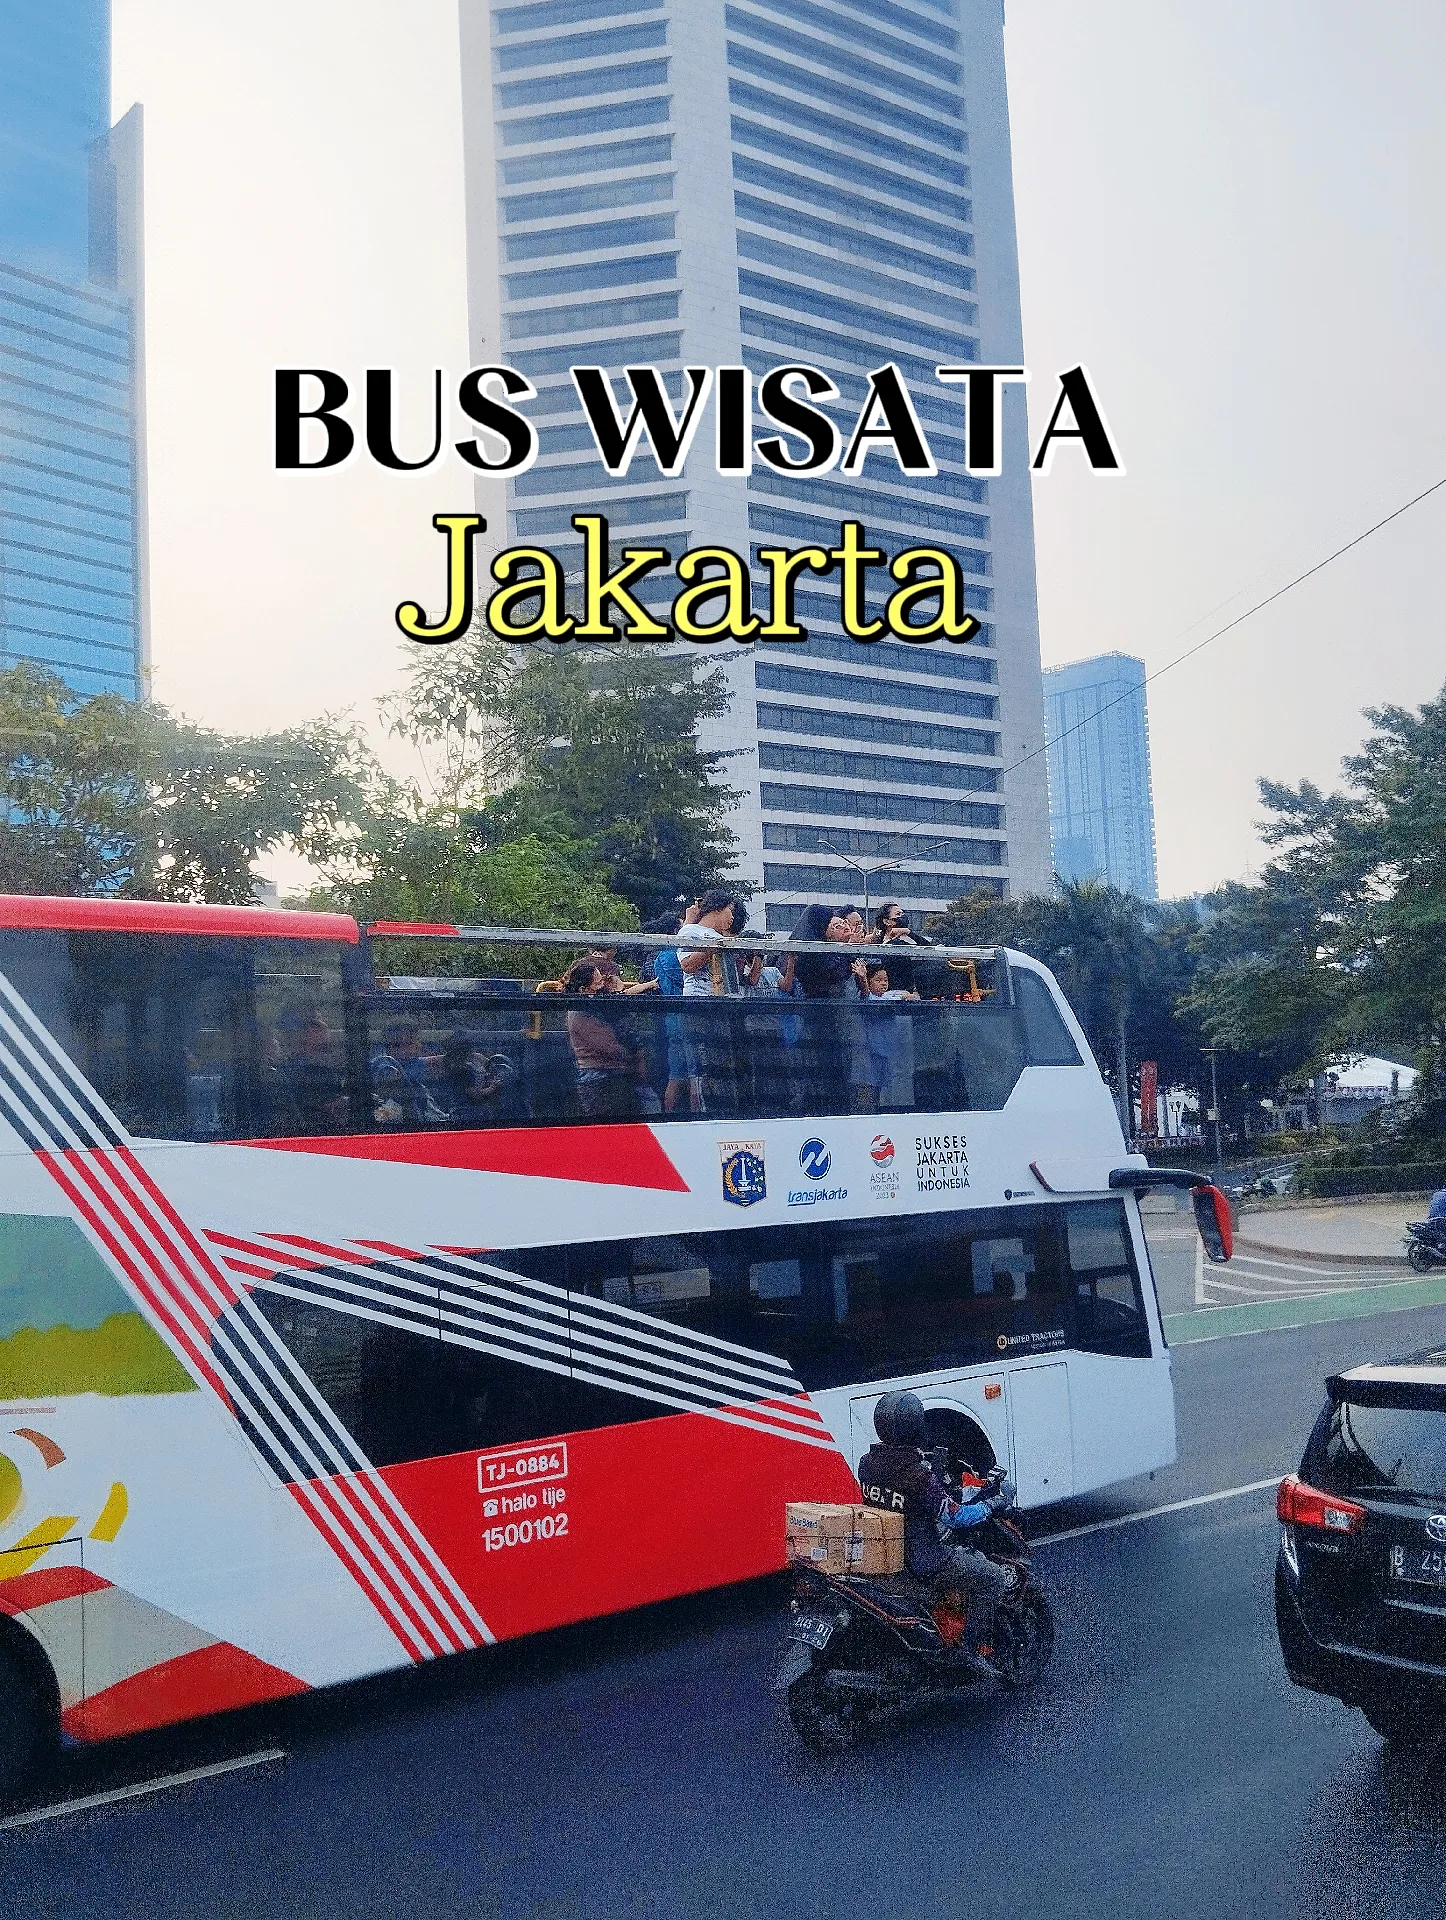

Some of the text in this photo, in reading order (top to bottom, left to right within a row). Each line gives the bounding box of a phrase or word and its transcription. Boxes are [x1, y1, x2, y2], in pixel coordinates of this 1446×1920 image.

[723, 1143, 740, 1151] JAYA
[915, 1135, 967, 1151] SUKSES
[916, 1150, 969, 1167] JAKARTA
[870, 1172, 900, 1184] ASEAN
[916, 1164, 970, 1180] UNTUK
[917, 1177, 971, 1192] INDONESIA
[787, 1186, 848, 1206] transjakarta
[1007, 1334, 1030, 1346] UNITED
[486, 1453, 560, 1482] TJ-0884
[501, 1492, 538, 1514] halo
[481, 1512, 569, 1553] 1500102
[1394, 1545, 1404, 1566] B
